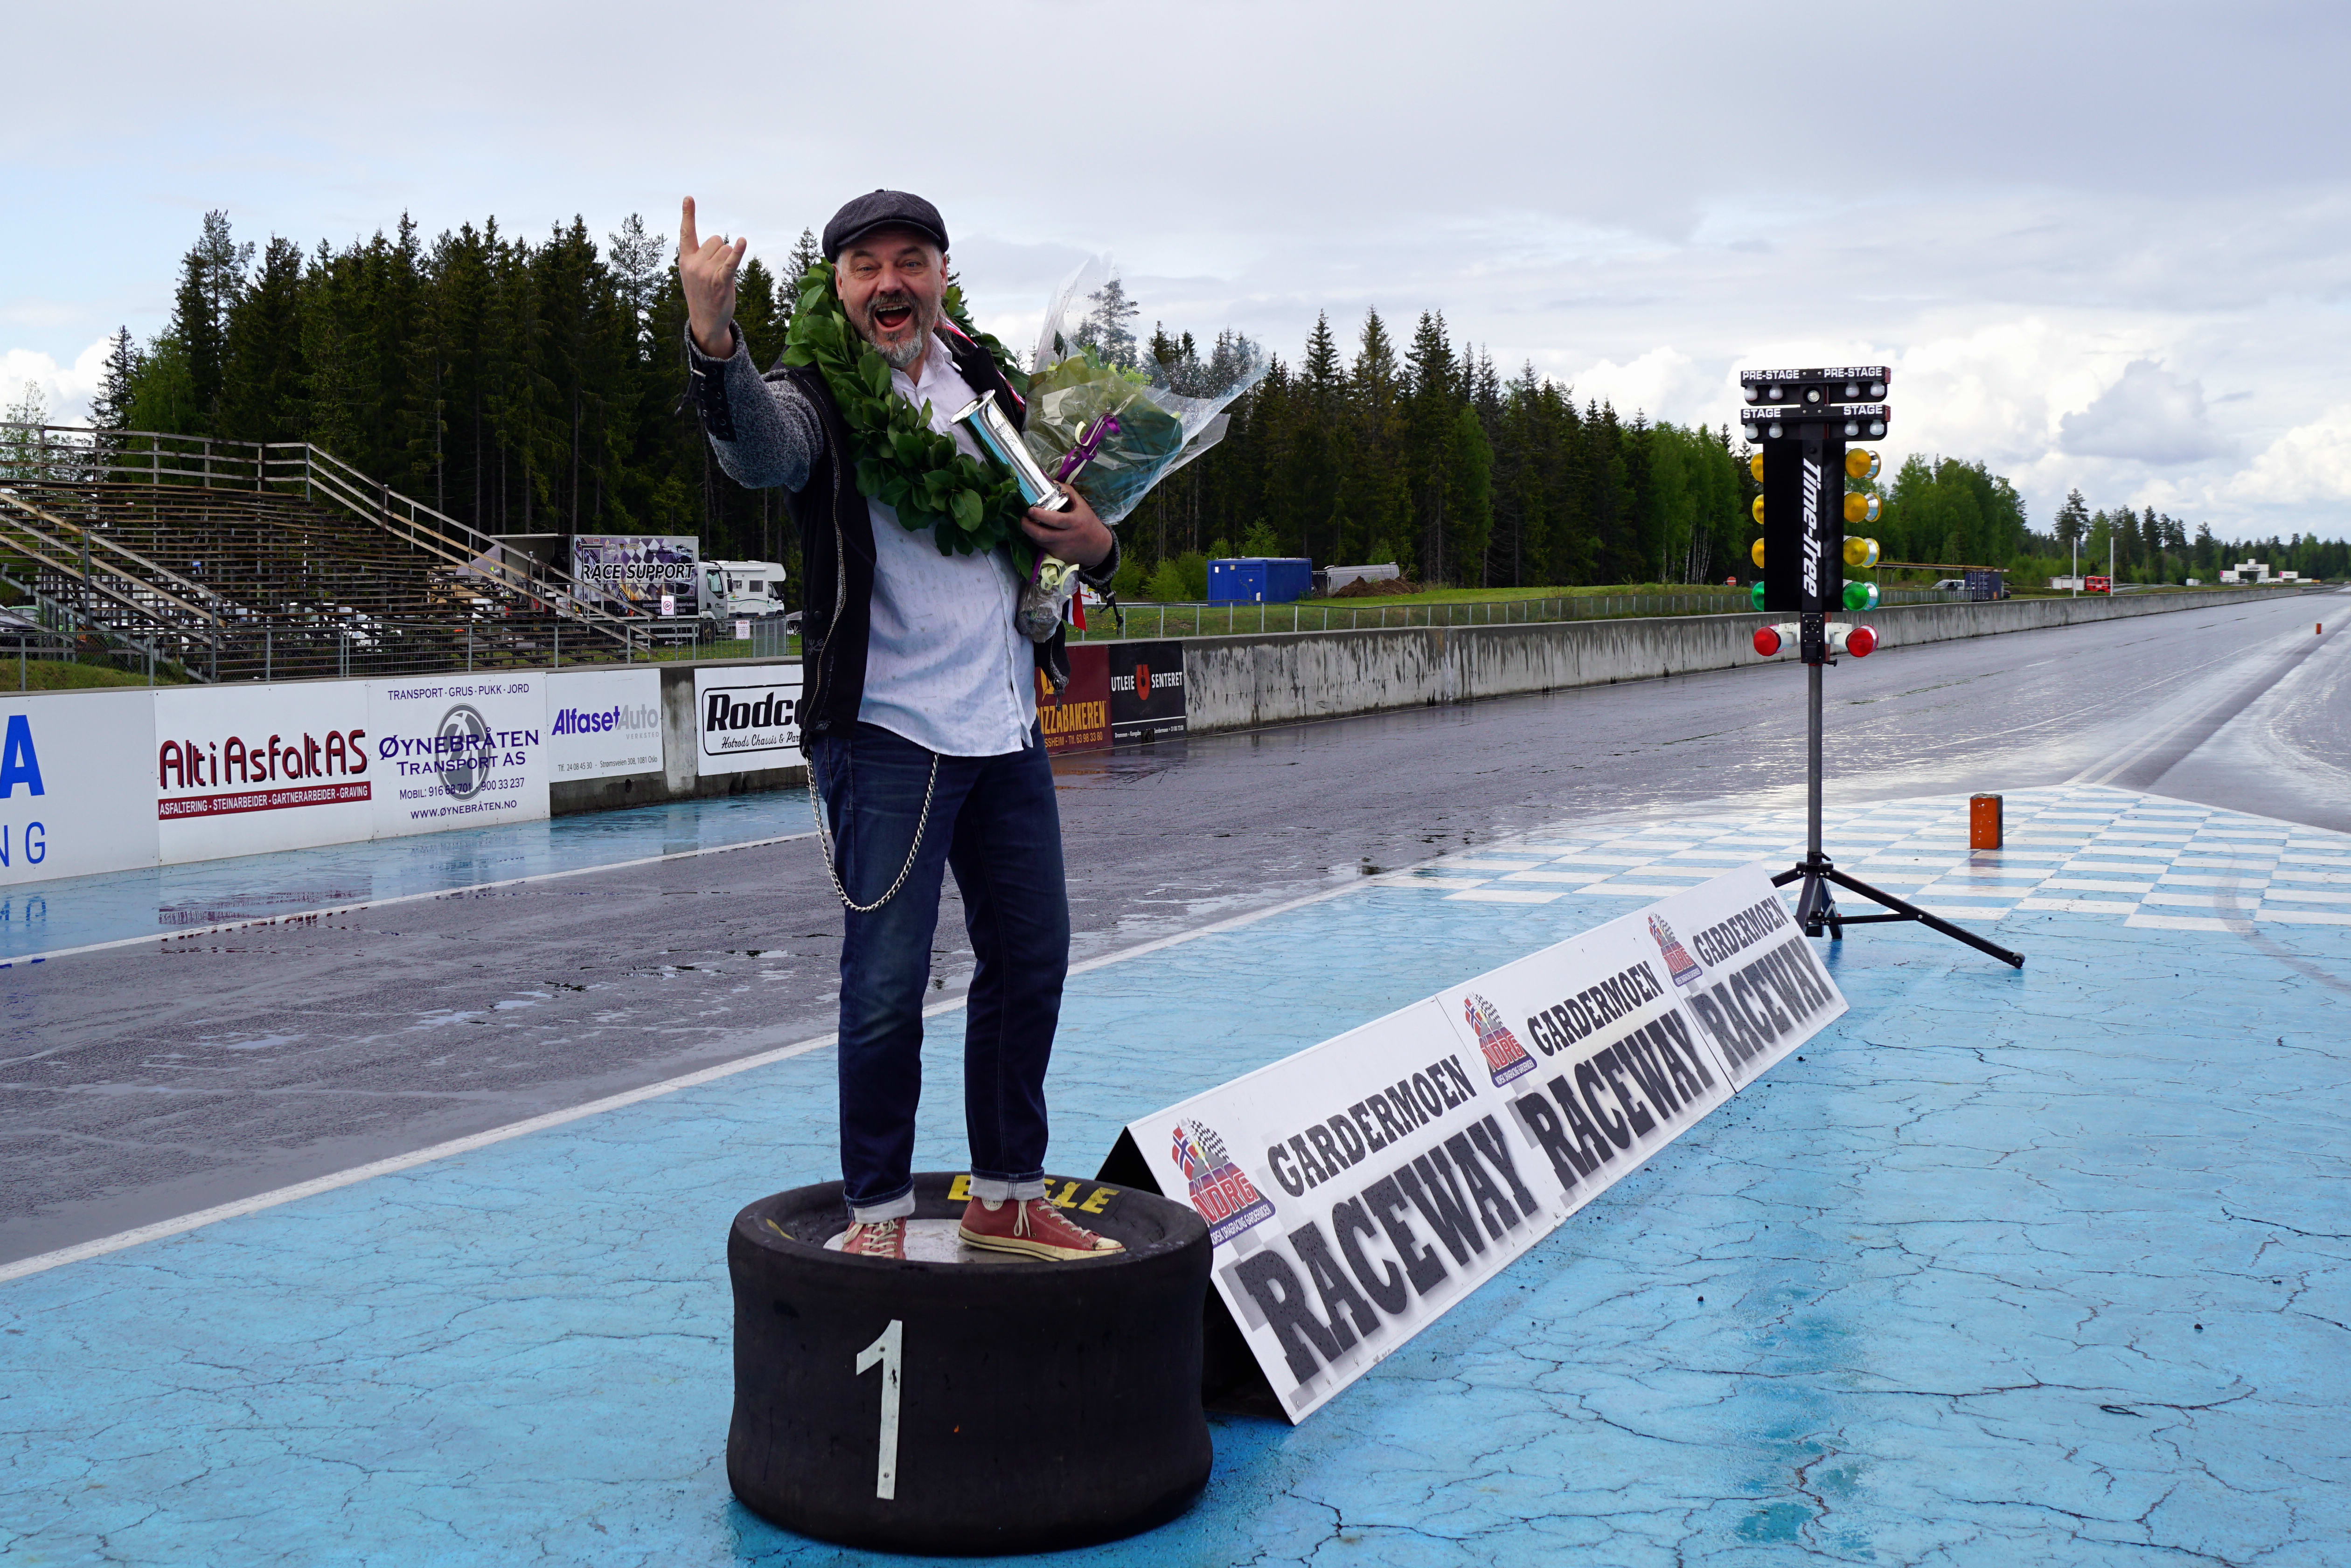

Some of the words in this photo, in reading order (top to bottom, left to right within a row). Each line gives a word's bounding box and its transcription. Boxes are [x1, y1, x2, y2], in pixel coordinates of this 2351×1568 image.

[1743, 369, 1799, 380] PRE-STAGE
[1824, 367, 1882, 378] PRE-STAGE
[1743, 408, 1781, 418] STAGE
[1843, 405, 1883, 415] STAGE
[1803, 458, 1822, 597] Time-Tree
[581, 563, 621, 580] RACE
[626, 563, 695, 579] SUPPORT
[388, 688, 443, 700] TRANSPORT
[449, 687, 473, 697] GRUS
[479, 685, 502, 695] PUKK
[507, 684, 529, 694] JORD
[1111, 675, 1135, 691] UTLEIE
[1151, 672, 1183, 688] SENTERET
[379, 727, 539, 760] ØYNEBRÅTEN
[722, 735, 750, 749] Hotrods
[751, 734, 776, 746] Chassis
[779, 734, 785, 743] &
[786, 731, 800, 742] Par
[1045, 736, 1064, 748] SSHEIM
[1076, 734, 1082, 744] 63
[1083, 733, 1089, 743] 98
[1090, 732, 1096, 742] 33
[1097, 731, 1103, 741] 80
[160, 740, 217, 789] Alti
[224, 733, 322, 784] Asfalt
[326, 729, 367, 776] AS
[396, 756, 498, 776] TRANSPORT
[502, 751, 526, 766] AS
[160, 800, 207, 815] ASFALTERING
[213, 794, 268, 811] STEINARBEIDER
[272, 788, 336, 805] GARTNERARBEIDER
[340, 785, 368, 798] GRAVING
[429, 786, 443, 797] 916
[445, 784, 455, 795] 68
[458, 783, 471, 794] 701
[481, 780, 496, 791] 900
[498, 779, 508, 790] 33
[510, 777, 524, 788] 237
[1693, 895, 1789, 967] GARDERMOEN
[1527, 961, 1664, 1056] GARDERMOEN
[1690, 935, 1833, 1070] RACEWAY
[1480, 1032, 1527, 1073] NDRG
[1515, 1008, 1716, 1190] RACEWAY
[1268, 1054, 1477, 1197] GARDERMOEN
[947, 1175, 1120, 1214] ELE
[1189, 1170, 1260, 1227] NDRG
[1210, 1229, 1225, 1245] ORSK
[1235, 1114, 1538, 1385] RACEWAY
[856, 1318, 903, 1500] 1
